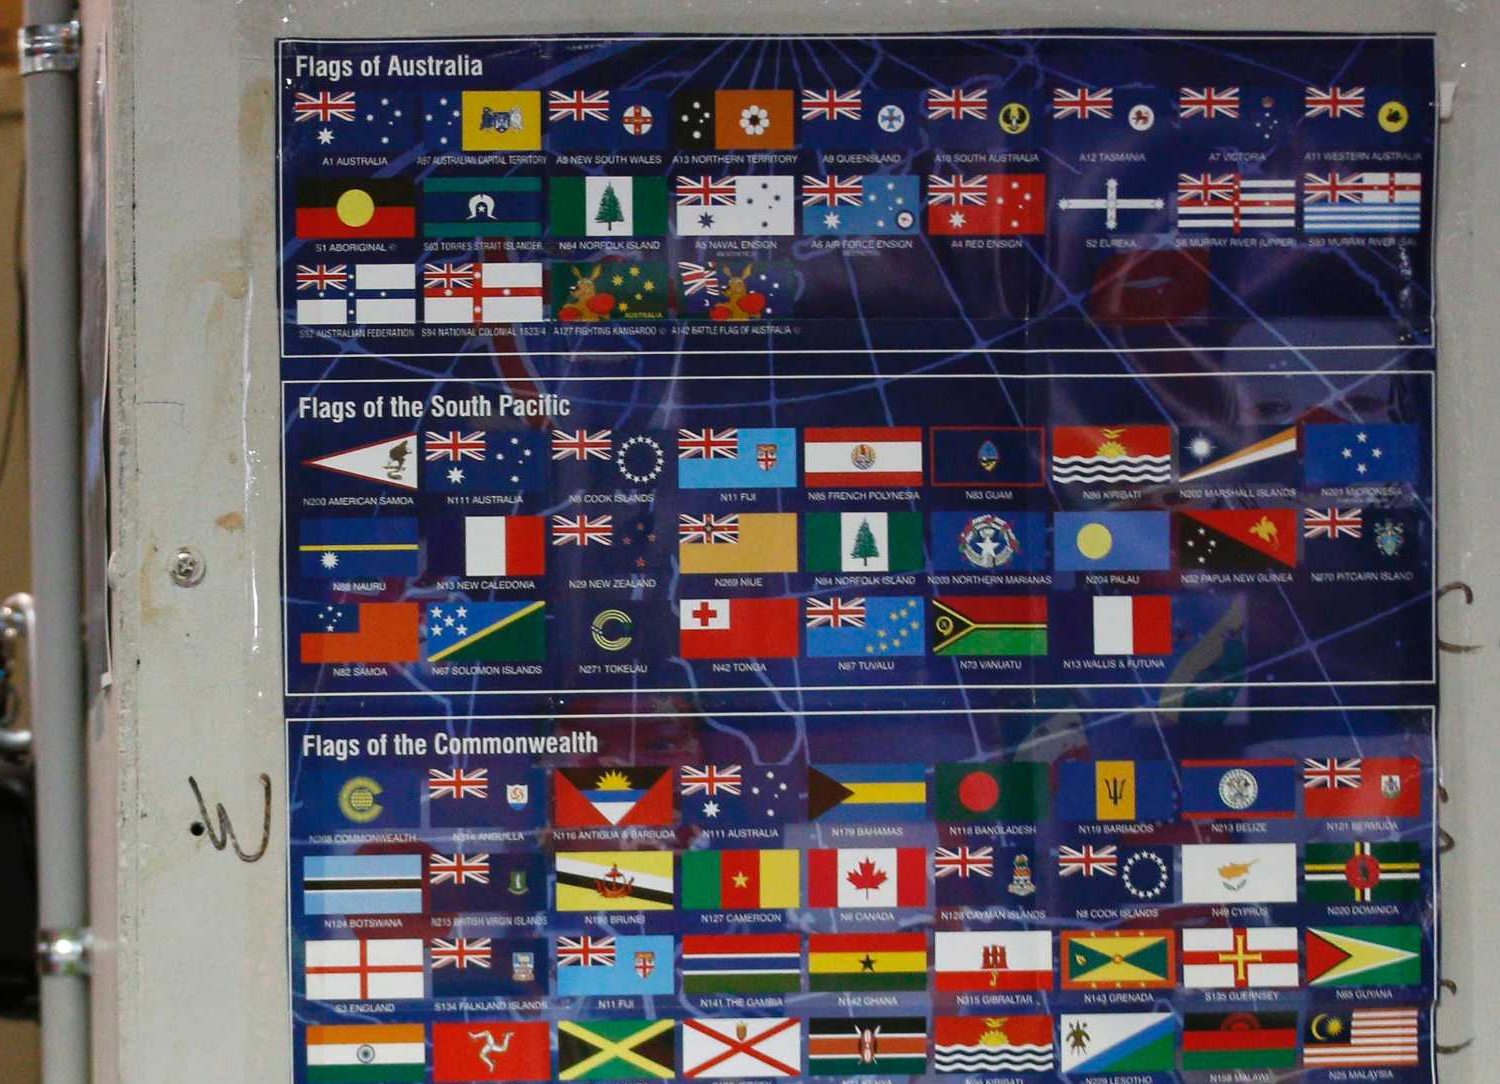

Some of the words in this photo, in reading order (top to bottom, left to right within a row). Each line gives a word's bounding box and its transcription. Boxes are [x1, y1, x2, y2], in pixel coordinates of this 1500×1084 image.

[296, 55, 353, 82] Flags
[360, 55, 381, 77] of
[387, 54, 483, 77] Australia
[570, 155, 593, 164] NEW
[595, 155, 627, 164] SOUTH
[629, 155, 661, 164] WALES
[691, 155, 744, 164] NORTHERN
[746, 154, 797, 164] TERRITORY
[835, 154, 900, 163] QUEENSLAND
[1098, 152, 1145, 161] TASMANIA
[322, 157, 333, 166] A1
[335, 157, 387, 166] AUSTRALIA
[328, 243, 386, 252] ABORIGINAL
[579, 241, 624, 250] NORFOLK
[627, 240, 660, 250] ISLAND
[709, 240, 739, 250] NAVAL
[741, 240, 776, 249] ENSIGN
[965, 239, 984, 249] RED
[987, 239, 1022, 248] ENSIGN
[316, 329, 365, 338] AUSTRALIAN
[299, 396, 356, 423] Flags
[363, 396, 384, 418] of
[390, 395, 424, 418] the
[431, 394, 491, 418] South
[499, 393, 570, 417] Pacific
[720, 493, 737, 502] N11
[739, 493, 756, 502] FIJI
[827, 491, 866, 501] FRENCH
[868, 491, 920, 500] POLYNESIA
[985, 490, 1012, 500] GUAM
[328, 496, 377, 505] AMERICAN
[379, 496, 413, 505] SAMOA
[447, 495, 469, 505] N111
[471, 495, 523, 504] AUSTRALIA
[569, 579, 586, 589] N29
[588, 579, 611, 588] NEW
[613, 579, 656, 588] ZEALAND
[740, 577, 762, 586] NIUE
[951, 575, 1004, 585] NORTHERN
[1005, 575, 1052, 584] MARIANAS
[1110, 575, 1139, 584] PALAU
[352, 582, 385, 591] NAURU
[456, 581, 479, 590] NEW
[481, 580, 535, 590] CALEDONIA
[579, 664, 601, 673] N271
[603, 664, 647, 673] TOKELAU
[713, 663, 730, 672] N42
[732, 663, 766, 672] TONGA
[858, 661, 894, 670] TUVALU
[960, 660, 977, 669] N73
[979, 660, 1021, 669] VANUATU
[1063, 660, 1081, 669] N13
[1083, 660, 1116, 669] WALLIS
[1128, 659, 1165, 668] FUTUNA
[333, 667, 351, 676] N82
[353, 667, 387, 676] SAMOA
[452, 666, 500, 675] SOLOMON
[502, 665, 541, 675] ISLANDS
[303, 734, 360, 761] Flags
[367, 733, 387, 756] of
[393, 733, 427, 756] the
[434, 731, 598, 755] Commonwealth
[702, 829, 724, 838] N111
[727, 829, 778, 838] AUSTRALIA
[858, 827, 902, 836] BAHAMAS
[726, 913, 781, 923] CAMEROON
[855, 912, 895, 921] CANADA
[1090, 909, 1118, 918] COOK
[1120, 909, 1158, 918] ISLANDS
[350, 919, 402, 928] BOTSWANA
[982, 995, 1032, 1004] GIBRALTAR
[1108, 993, 1154, 1002] GRENADA
[599, 999, 617, 1009] N11
[619, 999, 634, 1009] FIJI
[700, 998, 723, 1008] N141
[725, 998, 744, 1007] THE
[746, 998, 783, 1007] GAMBIA
[349, 1004, 395, 1013] ENGLAND
